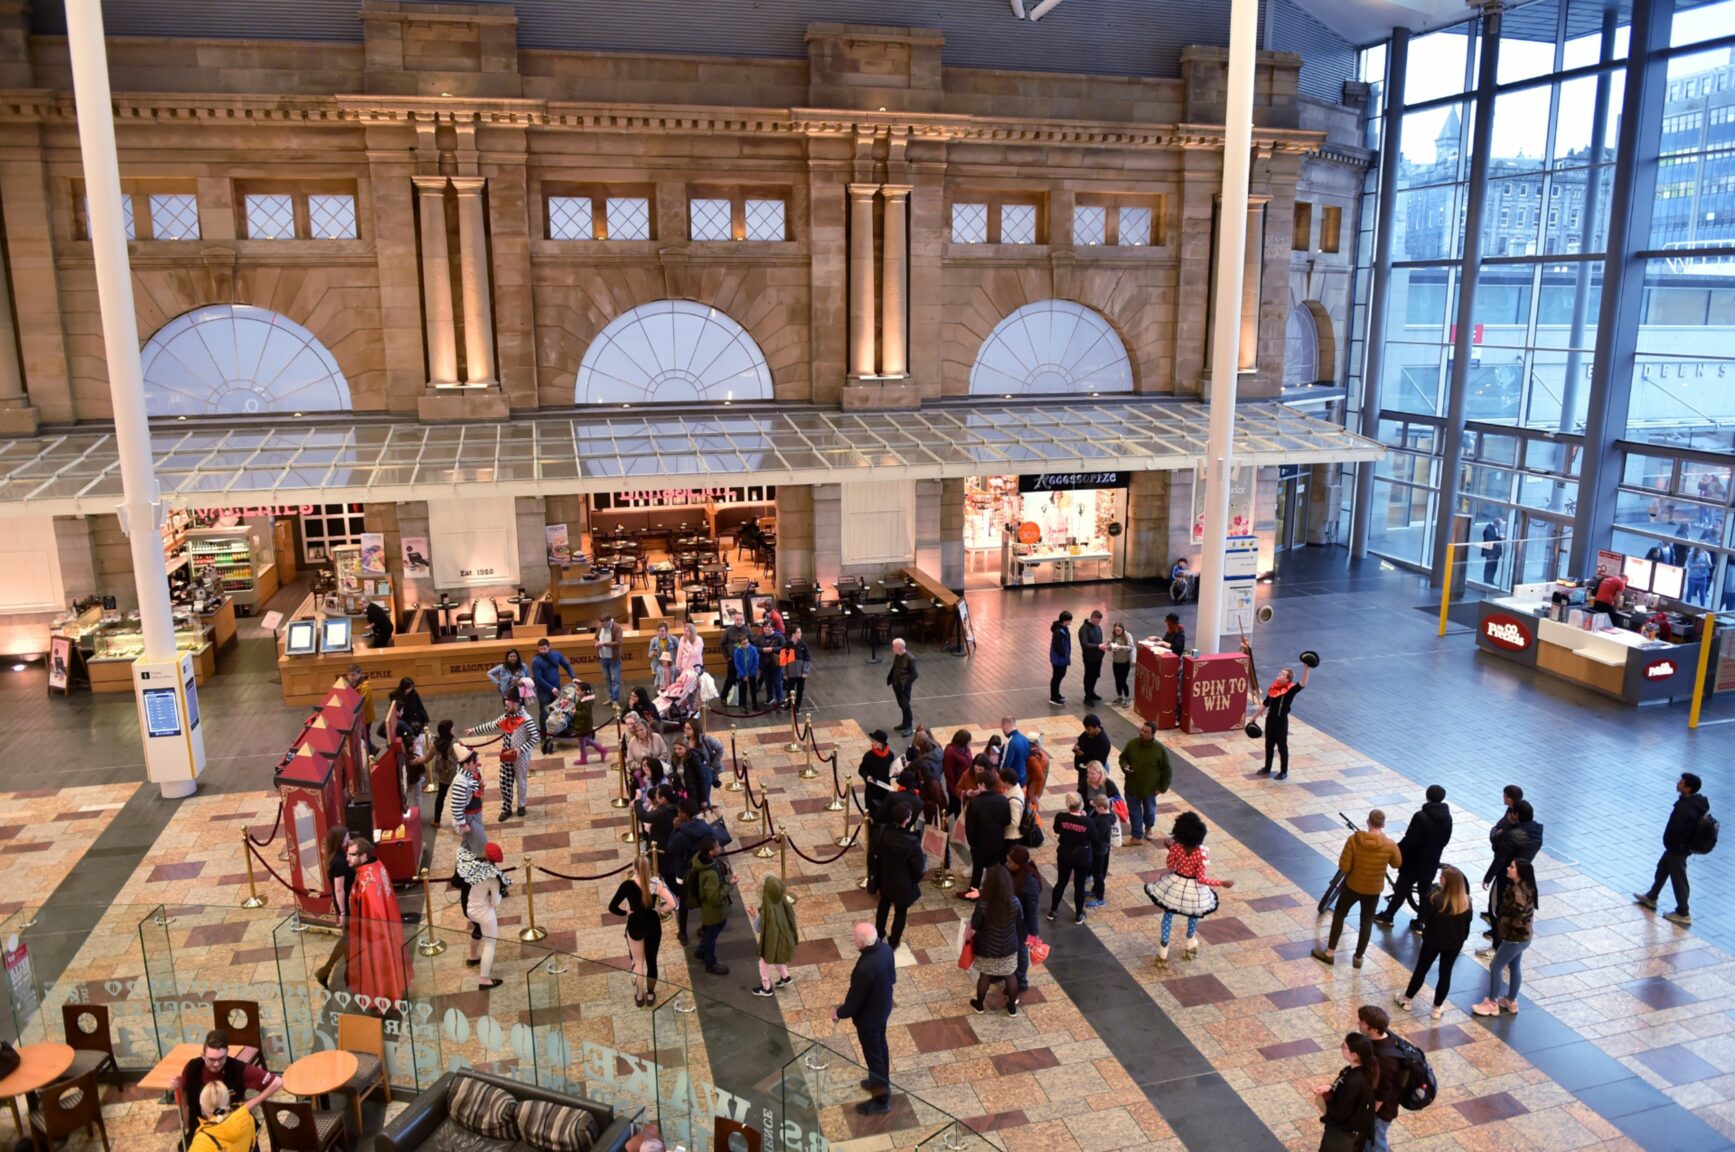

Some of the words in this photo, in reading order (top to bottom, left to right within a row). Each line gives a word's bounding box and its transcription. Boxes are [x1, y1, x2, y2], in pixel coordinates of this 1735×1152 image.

[1193, 679, 1226, 697] SPIN
[1229, 677, 1246, 694] TO
[1204, 694, 1231, 711] WIN
